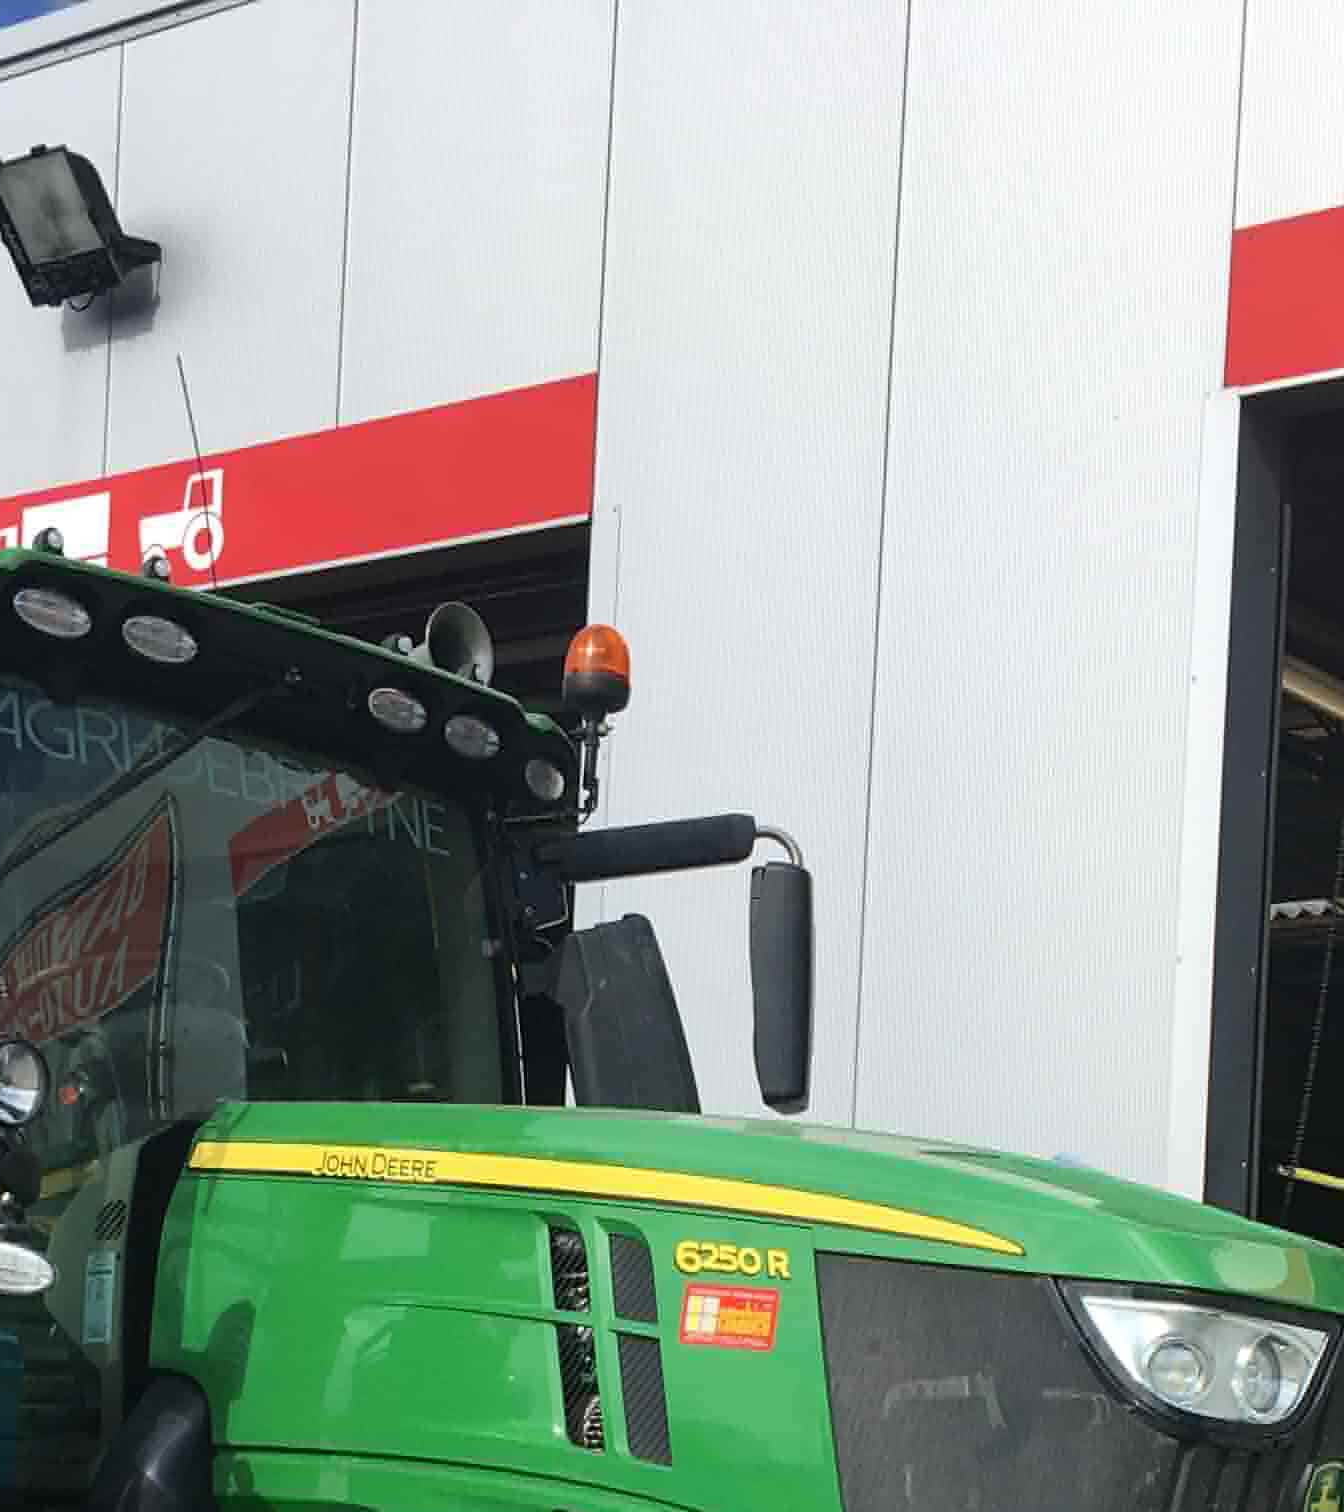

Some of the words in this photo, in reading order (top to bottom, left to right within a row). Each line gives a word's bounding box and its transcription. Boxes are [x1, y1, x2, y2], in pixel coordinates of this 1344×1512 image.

[315, 1151, 367, 1174] JOHN
[371, 1152, 438, 1178] DEERE
[674, 1240, 761, 1275] 6250
[766, 1248, 792, 1280] R
